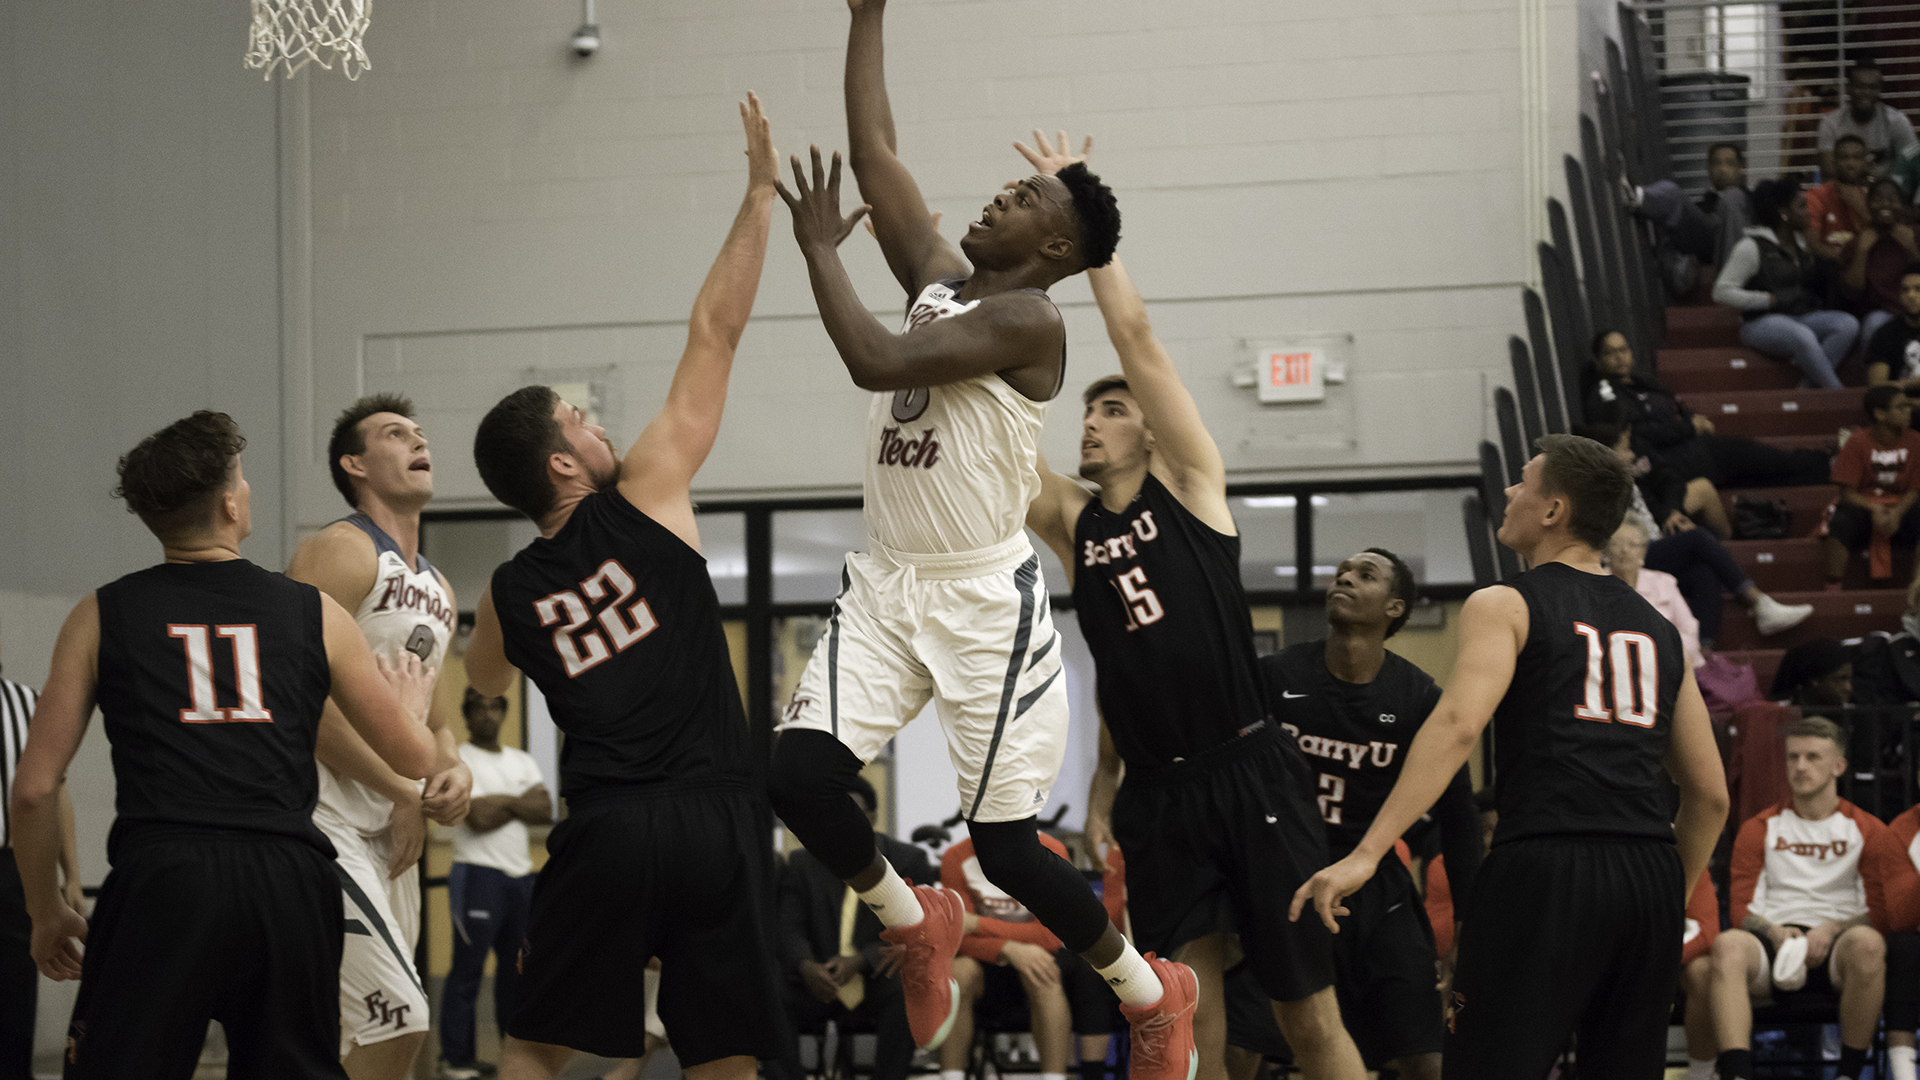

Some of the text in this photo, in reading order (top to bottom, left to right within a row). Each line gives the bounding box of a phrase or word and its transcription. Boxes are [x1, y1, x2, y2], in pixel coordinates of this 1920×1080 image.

[1271, 353, 1312, 387] EXIT
[878, 425, 941, 470] Tech
[373, 573, 453, 632] Florida
[532, 558, 660, 679] 22
[166, 623, 274, 723] 11
[1573, 621, 1659, 729] 10
[1317, 772, 1345, 825] 2
[363, 989, 411, 1031] FIT
